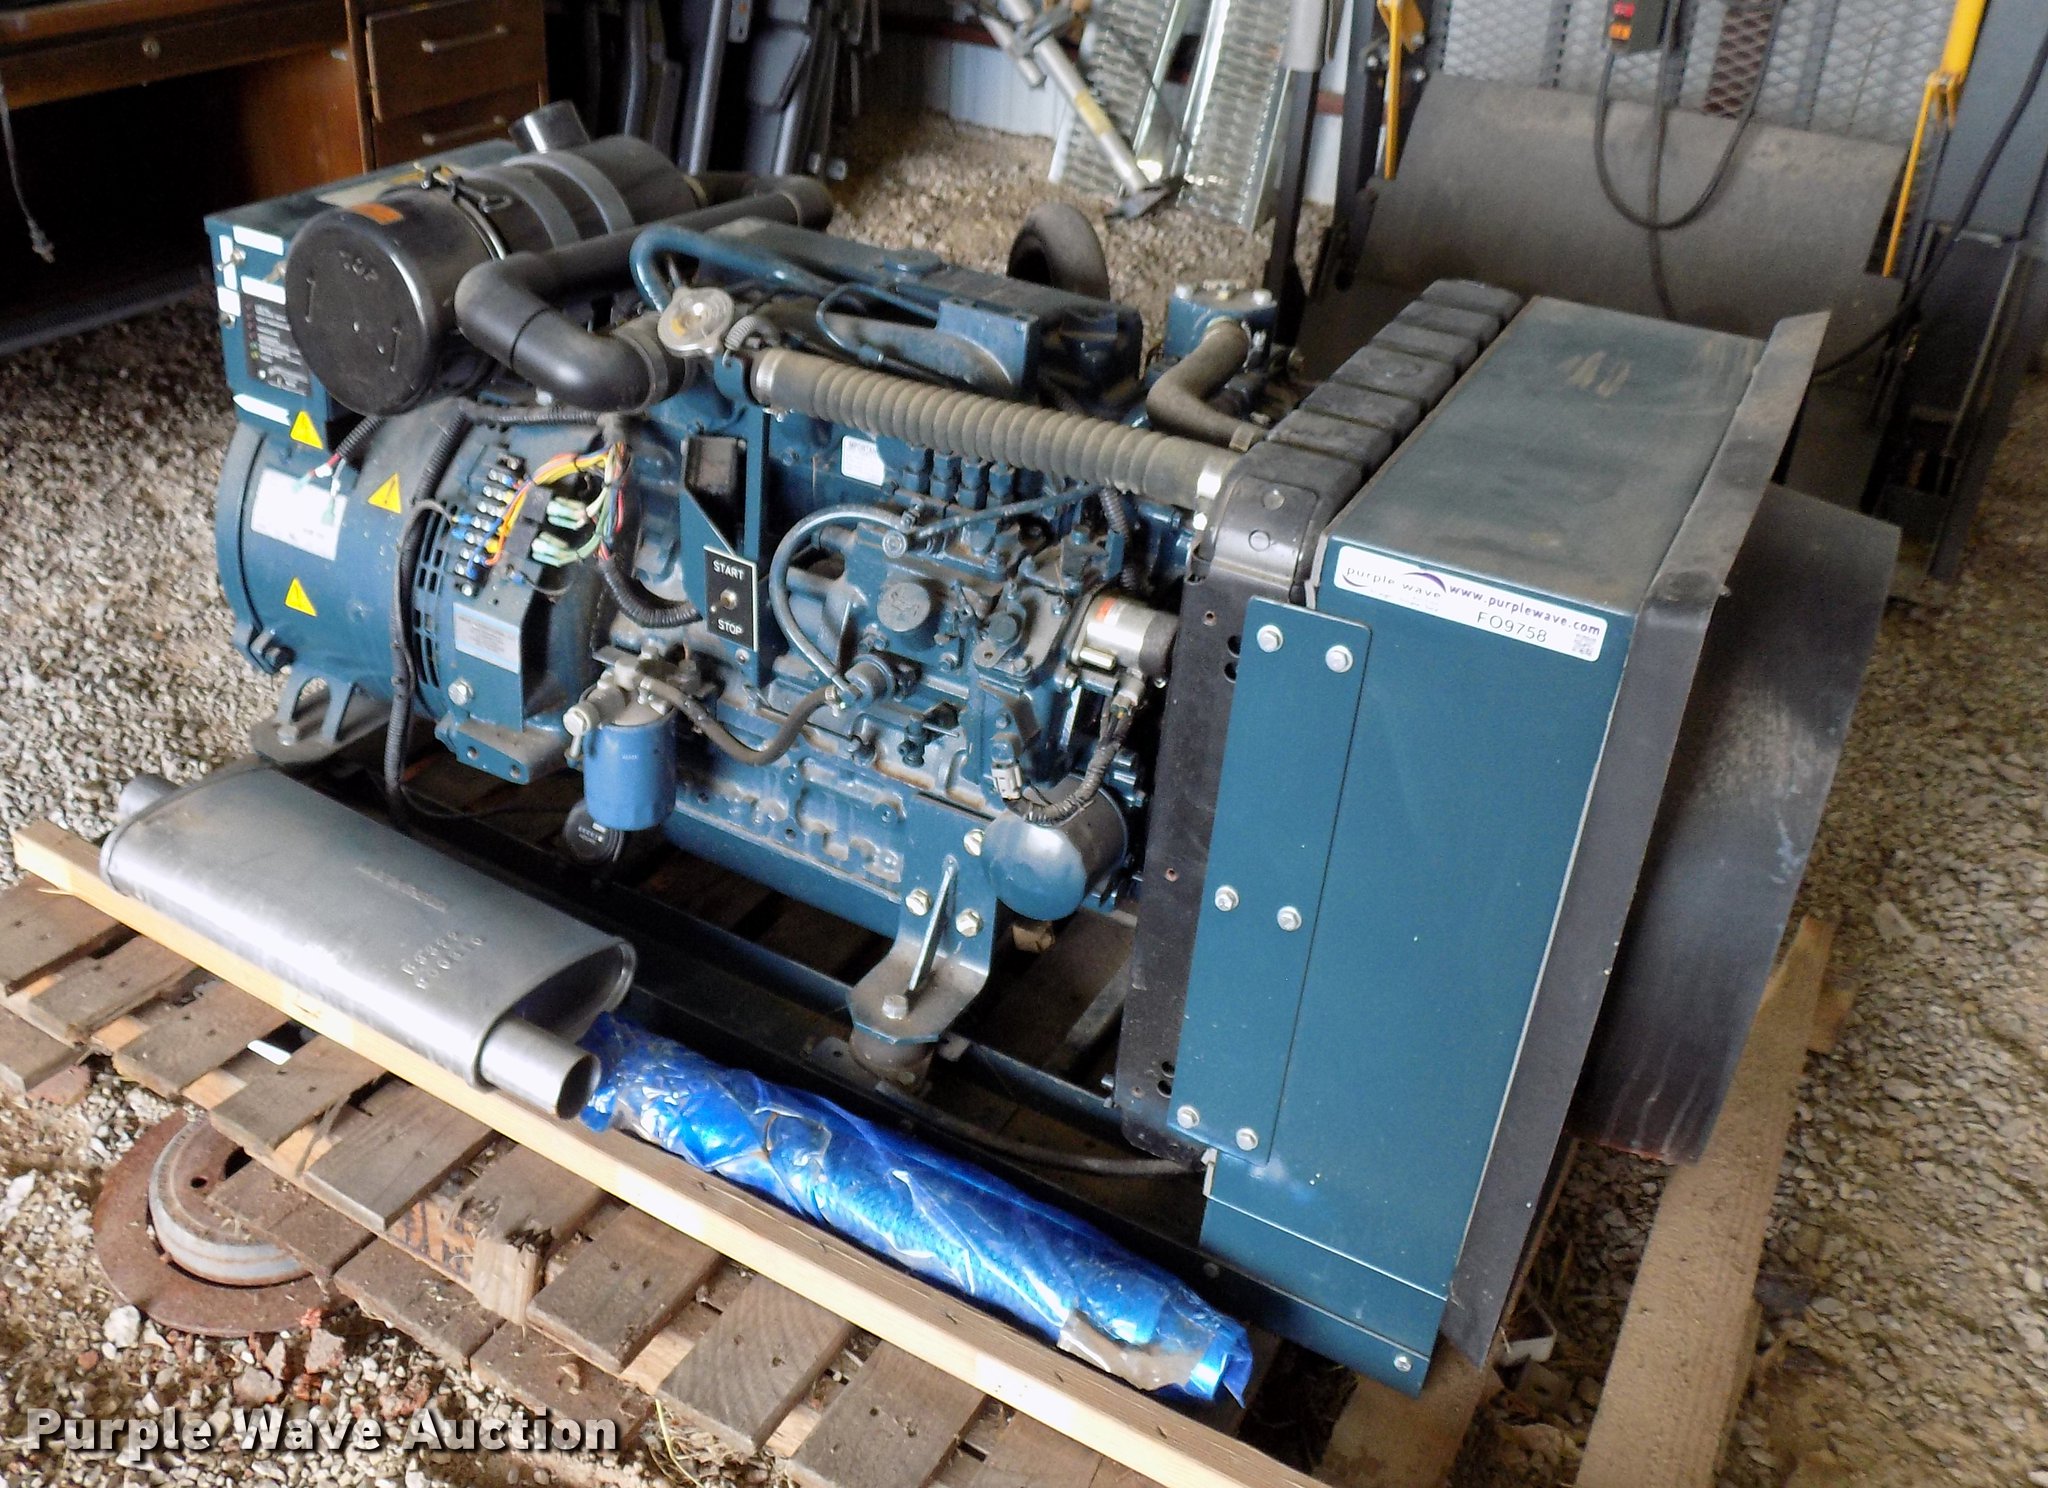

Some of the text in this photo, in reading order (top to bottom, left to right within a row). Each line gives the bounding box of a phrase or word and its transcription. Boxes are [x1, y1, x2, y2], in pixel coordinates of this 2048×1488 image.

[713, 560, 744, 579] START
[1346, 567, 1441, 599] purple wave
[1449, 585, 1601, 636] www.purplewave.com
[717, 619, 743, 636] STOP
